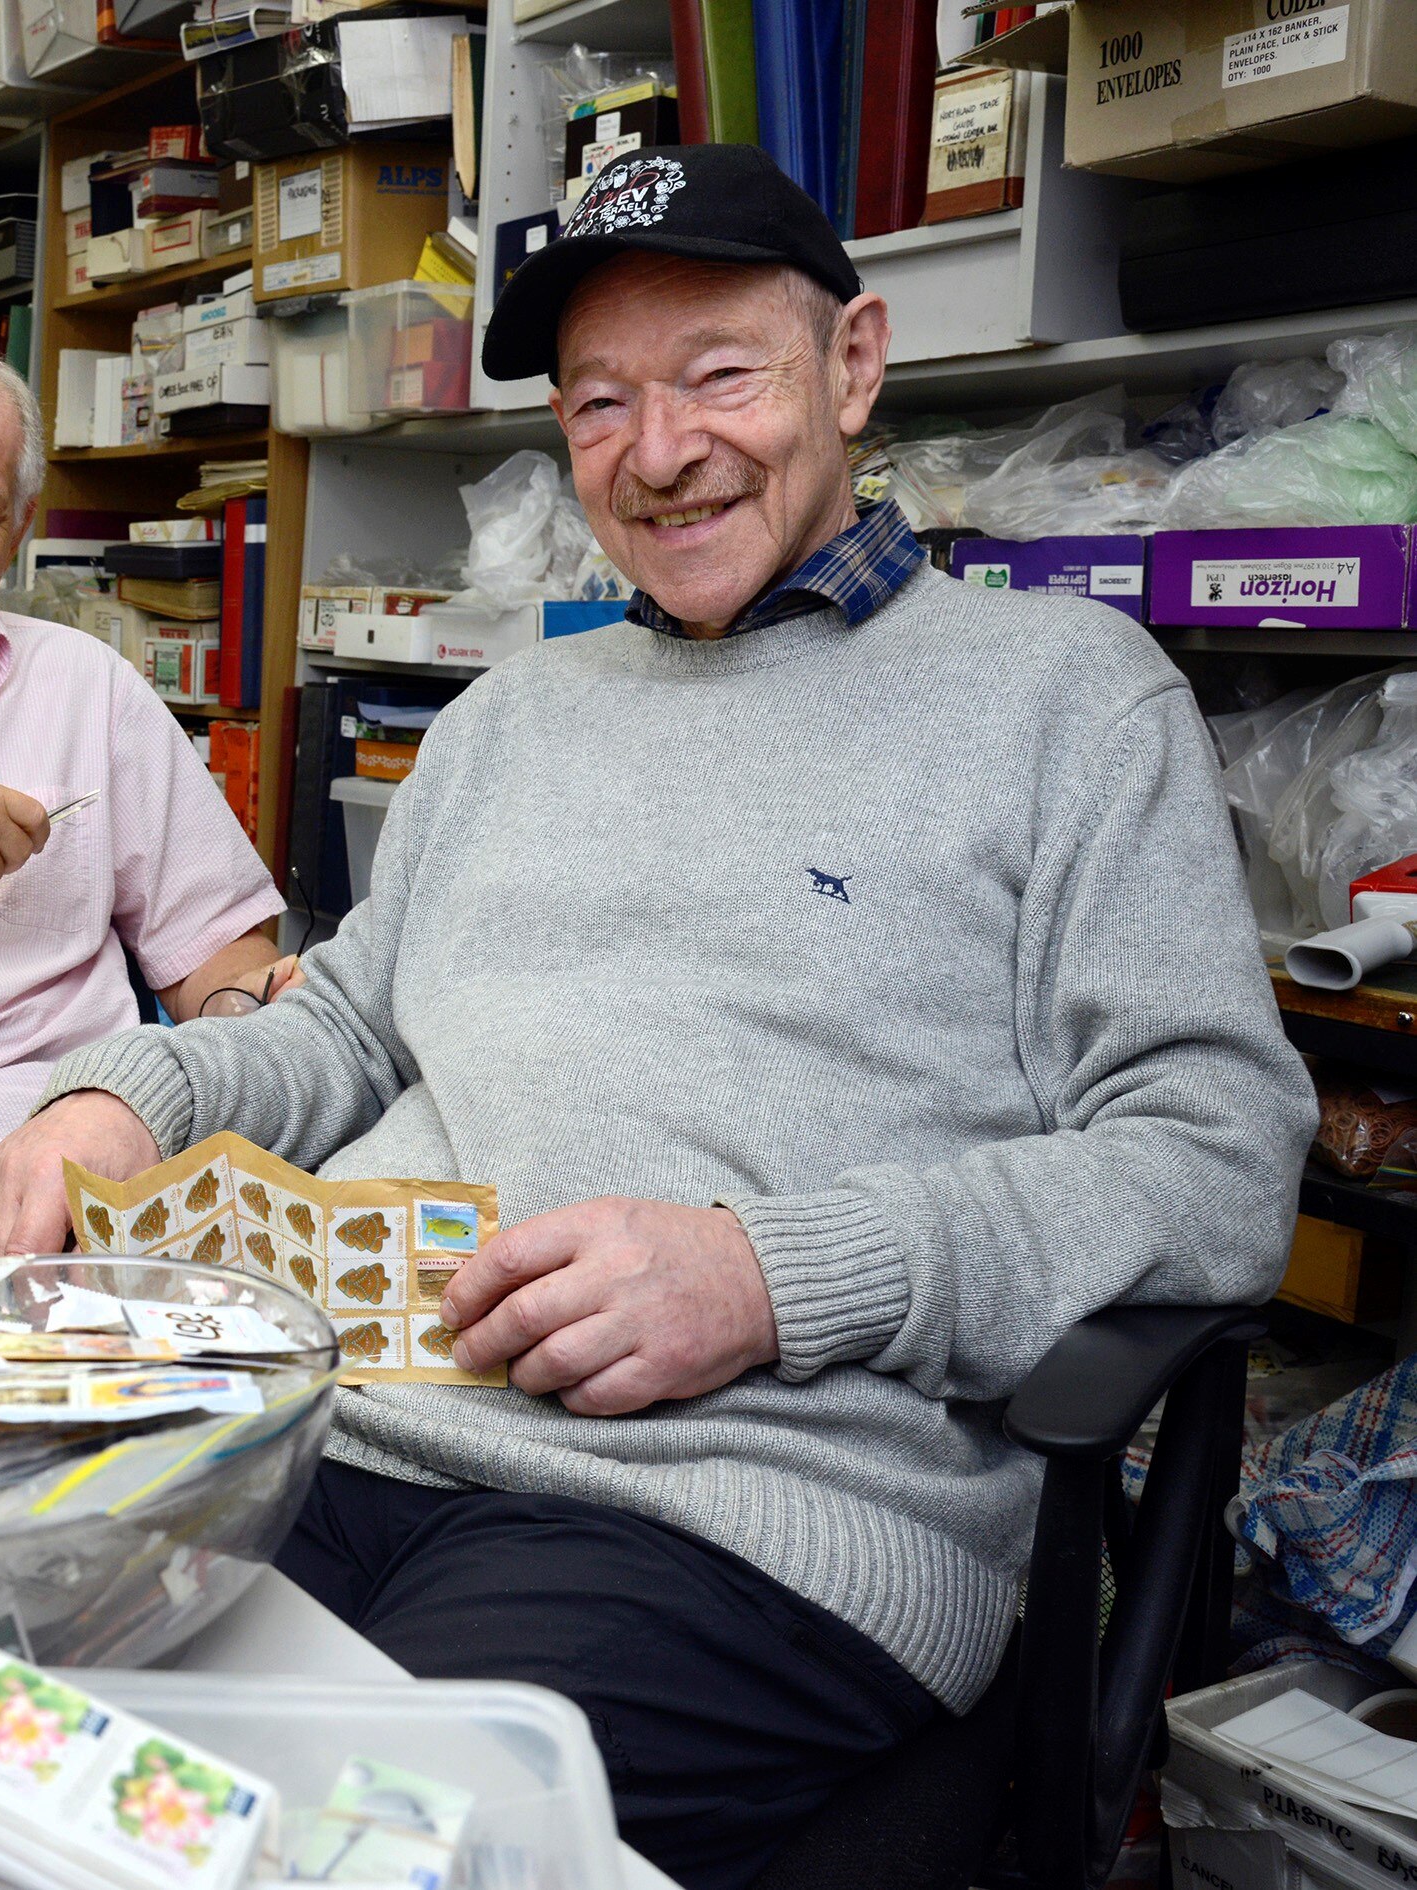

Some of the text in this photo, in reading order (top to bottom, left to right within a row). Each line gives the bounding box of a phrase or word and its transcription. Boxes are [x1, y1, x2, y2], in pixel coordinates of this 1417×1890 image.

[1229, 45, 1254, 58] PLAIN
[1282, 33, 1301, 45] LICK
[1303, 31, 1310, 40] &
[1313, 23, 1339, 37] STICK
[1259, 30, 1266, 39] X
[1268, 26, 1283, 36] 162
[1099, 31, 1143, 69] 1000
[1228, 64, 1271, 81] QTY: 1000
[378, 165, 443, 188] ALPS
[1206, 574, 1225, 582] UPM
[1337, 562, 1356, 575] A4
[1240, 580, 1336, 604] Horizon
[1263, 1786, 1354, 1851] PLASTIC
